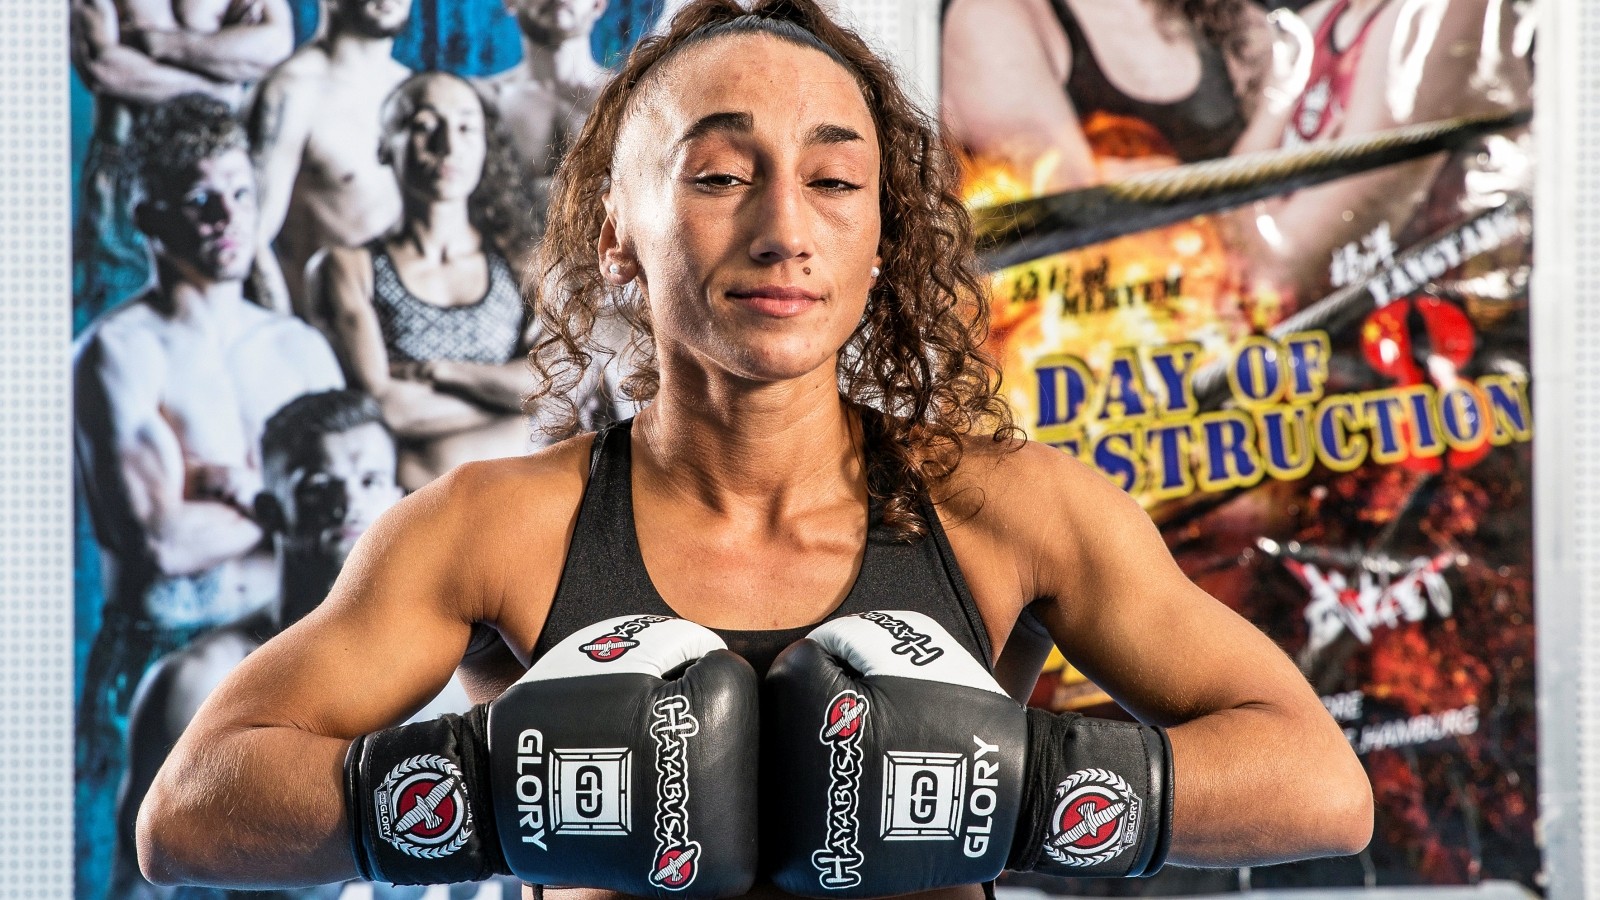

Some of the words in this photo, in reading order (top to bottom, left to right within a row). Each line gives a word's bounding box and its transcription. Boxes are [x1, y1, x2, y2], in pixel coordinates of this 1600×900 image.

[1033, 344, 1198, 433] DAY
[1230, 332, 1329, 404] OF
[1048, 378, 1530, 495] STRUCTION
[381, 804, 391, 836] GLORY
[516, 728, 547, 851] GLORY
[651, 696, 698, 851] HAYABUSA
[813, 734, 863, 888] HAYABUSA
[963, 735, 999, 858] GLORY
[1127, 800, 1138, 832] GLORY
